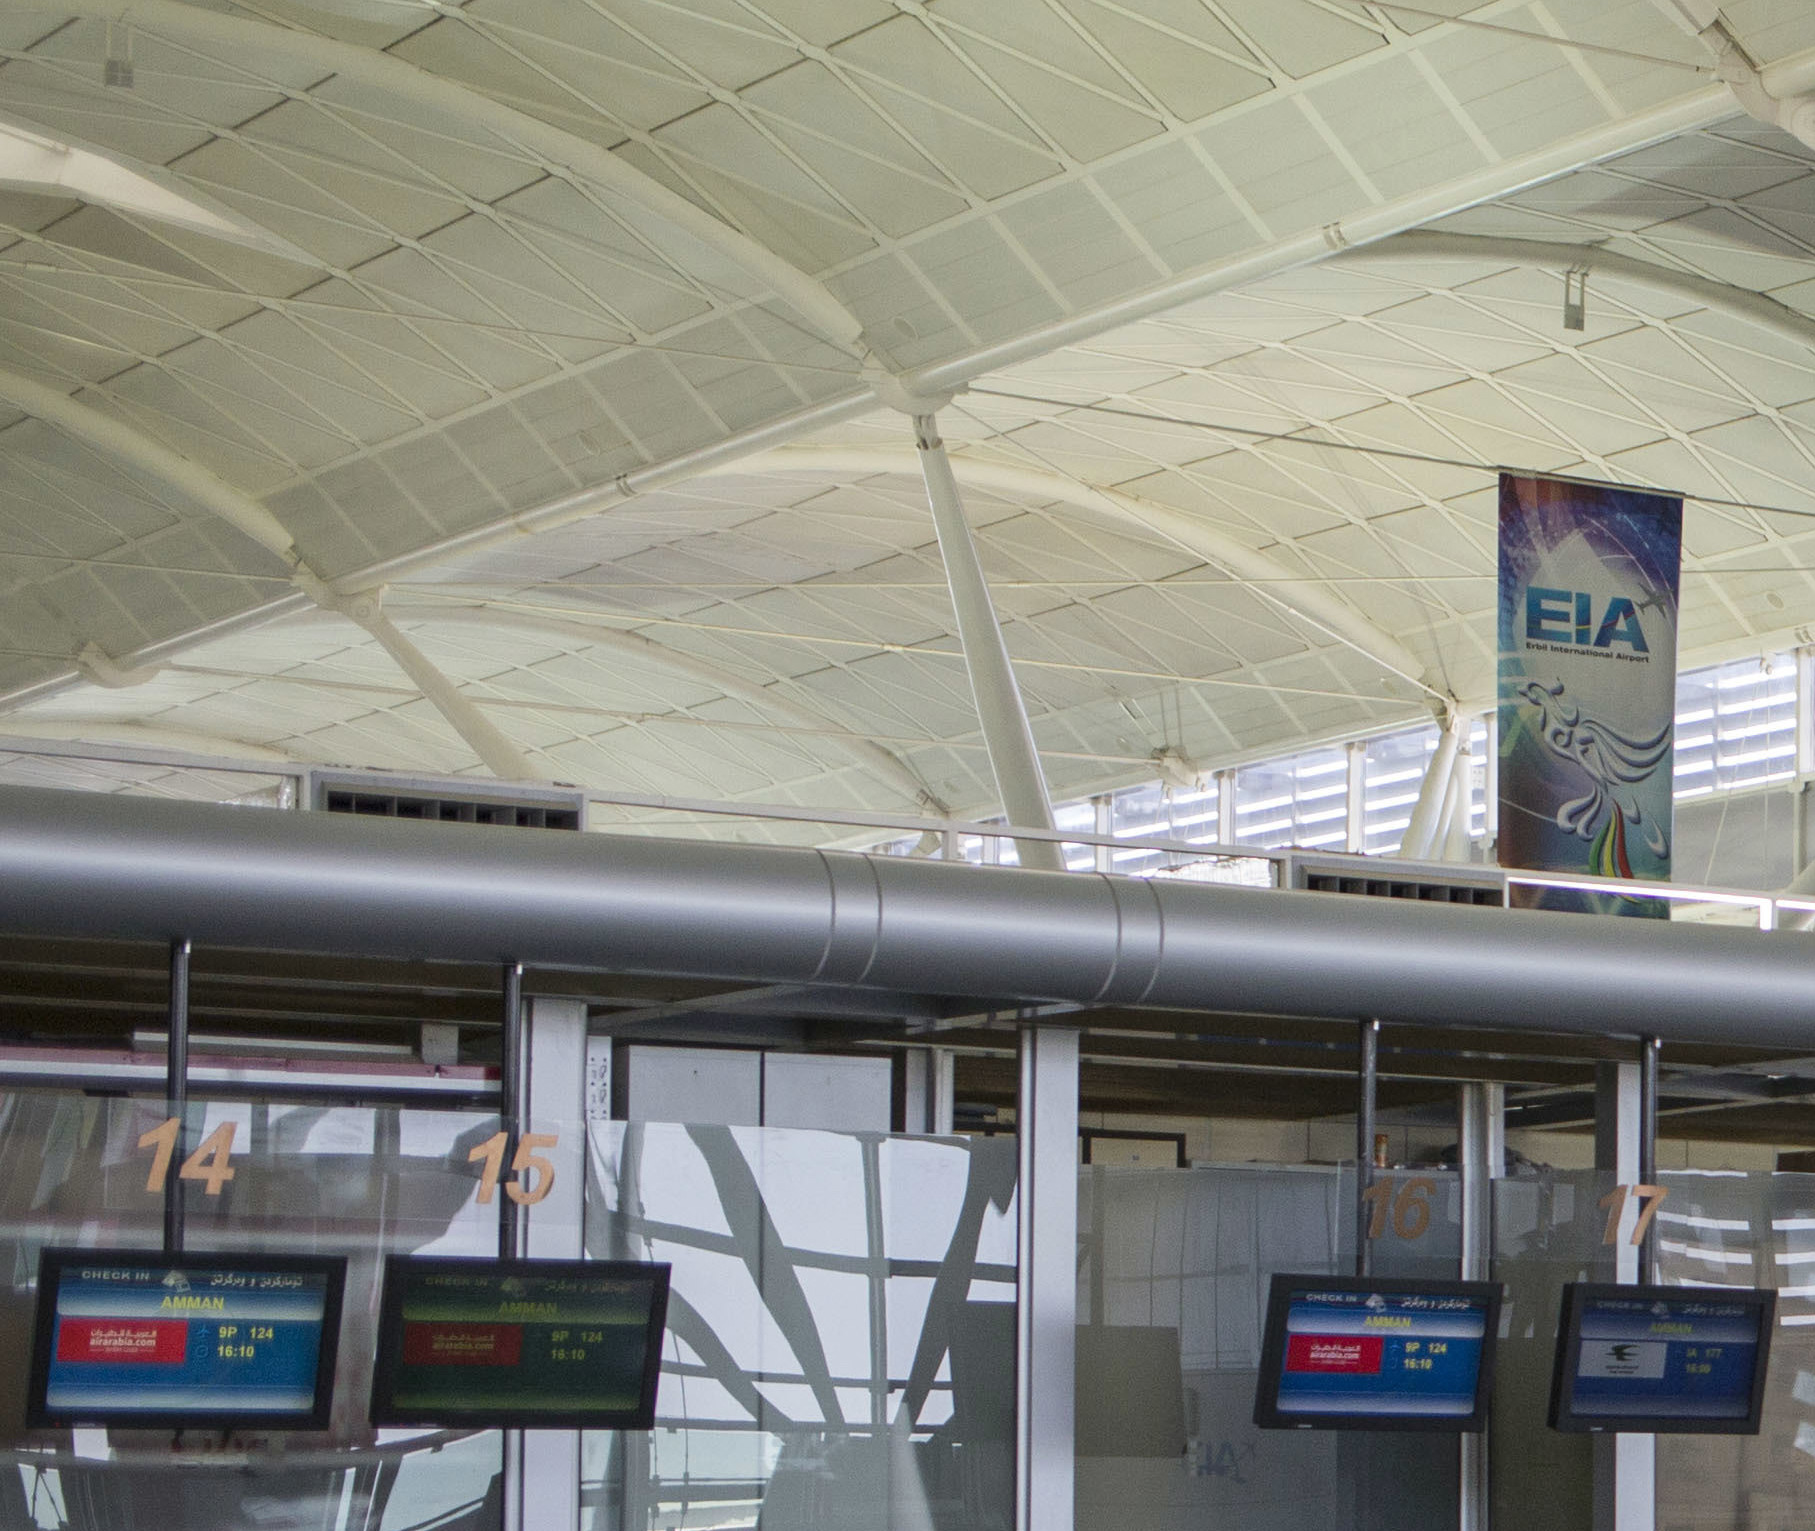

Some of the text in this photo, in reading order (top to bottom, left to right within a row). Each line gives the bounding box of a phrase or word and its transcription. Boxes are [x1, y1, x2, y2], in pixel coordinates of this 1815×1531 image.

[1526, 586, 1650, 654] EIA
[1526, 641, 1650, 664] Erbil International Airport
[138, 1117, 238, 1195] 14
[468, 1131, 558, 1205] 15
[1363, 1176, 1437, 1240] 16
[1597, 1184, 1670, 1245] 17
[82, 1270, 150, 1280] CHECK IN
[160, 1296, 225, 1309] AMMAN
[90, 1337, 156, 1347] airarabia.com
[218, 1326, 274, 1339] 9P 124
[217, 1346, 255, 1358] 16:10
